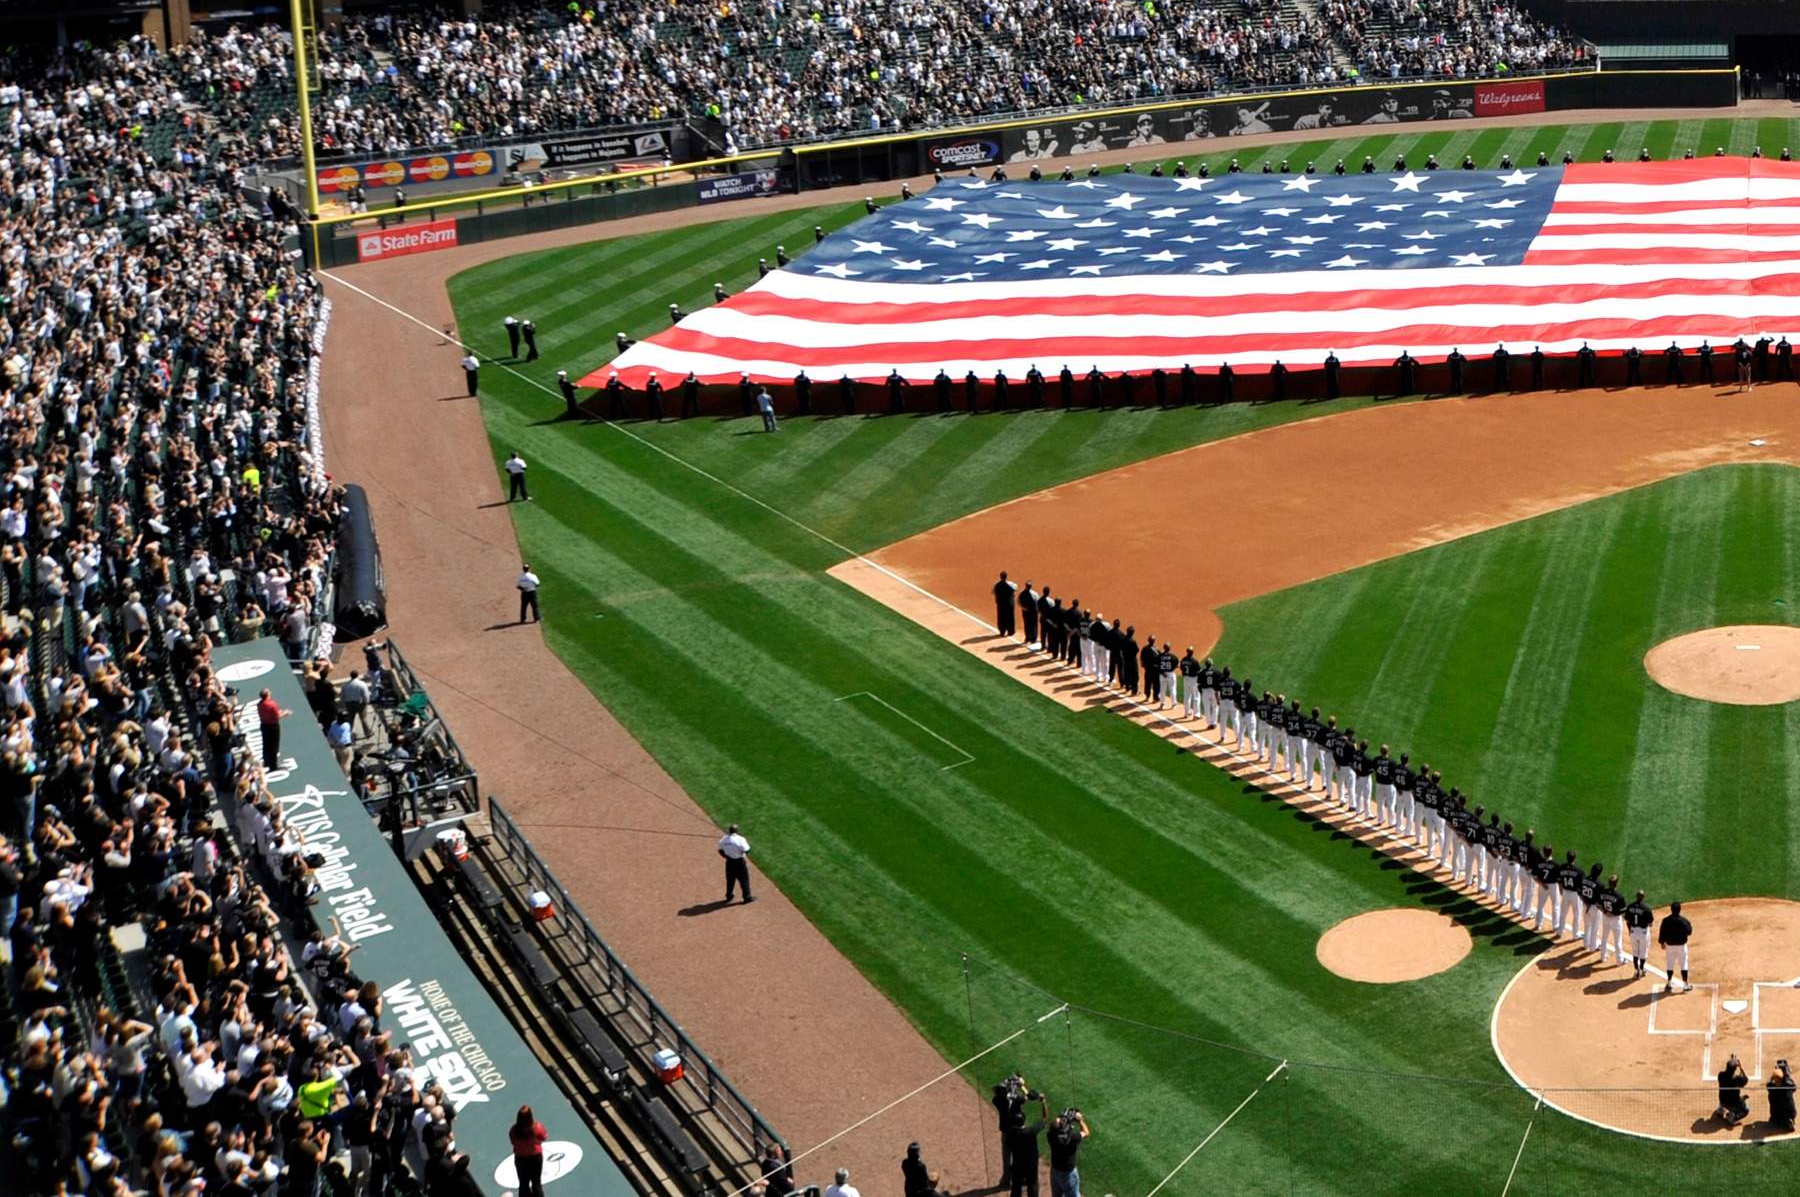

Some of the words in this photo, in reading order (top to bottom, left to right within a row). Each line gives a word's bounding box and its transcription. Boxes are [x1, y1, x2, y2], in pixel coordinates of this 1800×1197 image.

[1479, 92, 1540, 105] Walgreens
[714, 178, 742, 188] WATCH
[700, 189, 717, 199] MLB
[718, 184, 755, 197] TONIGHT
[382, 232, 420, 251] State
[420, 227, 456, 245] Farm
[1288, 722, 1300, 731] 34
[1377, 766, 1388, 776] 45
[1426, 794, 1437, 804] 55
[1487, 835, 1495, 844] 10
[265, 758, 297, 783] To
[329, 886, 394, 942] Field
[1543, 870, 1549, 879] 7
[1564, 877, 1574, 887] 14
[1582, 886, 1593, 898] 20
[1604, 901, 1613, 911] 15
[420, 980, 451, 1010] HOME
[438, 1008, 462, 1024] OF
[449, 1022, 476, 1048] THE
[382, 978, 452, 1057] WHITE
[426, 1051, 490, 1113] SOX
[461, 1041, 506, 1092] CHICAGO
